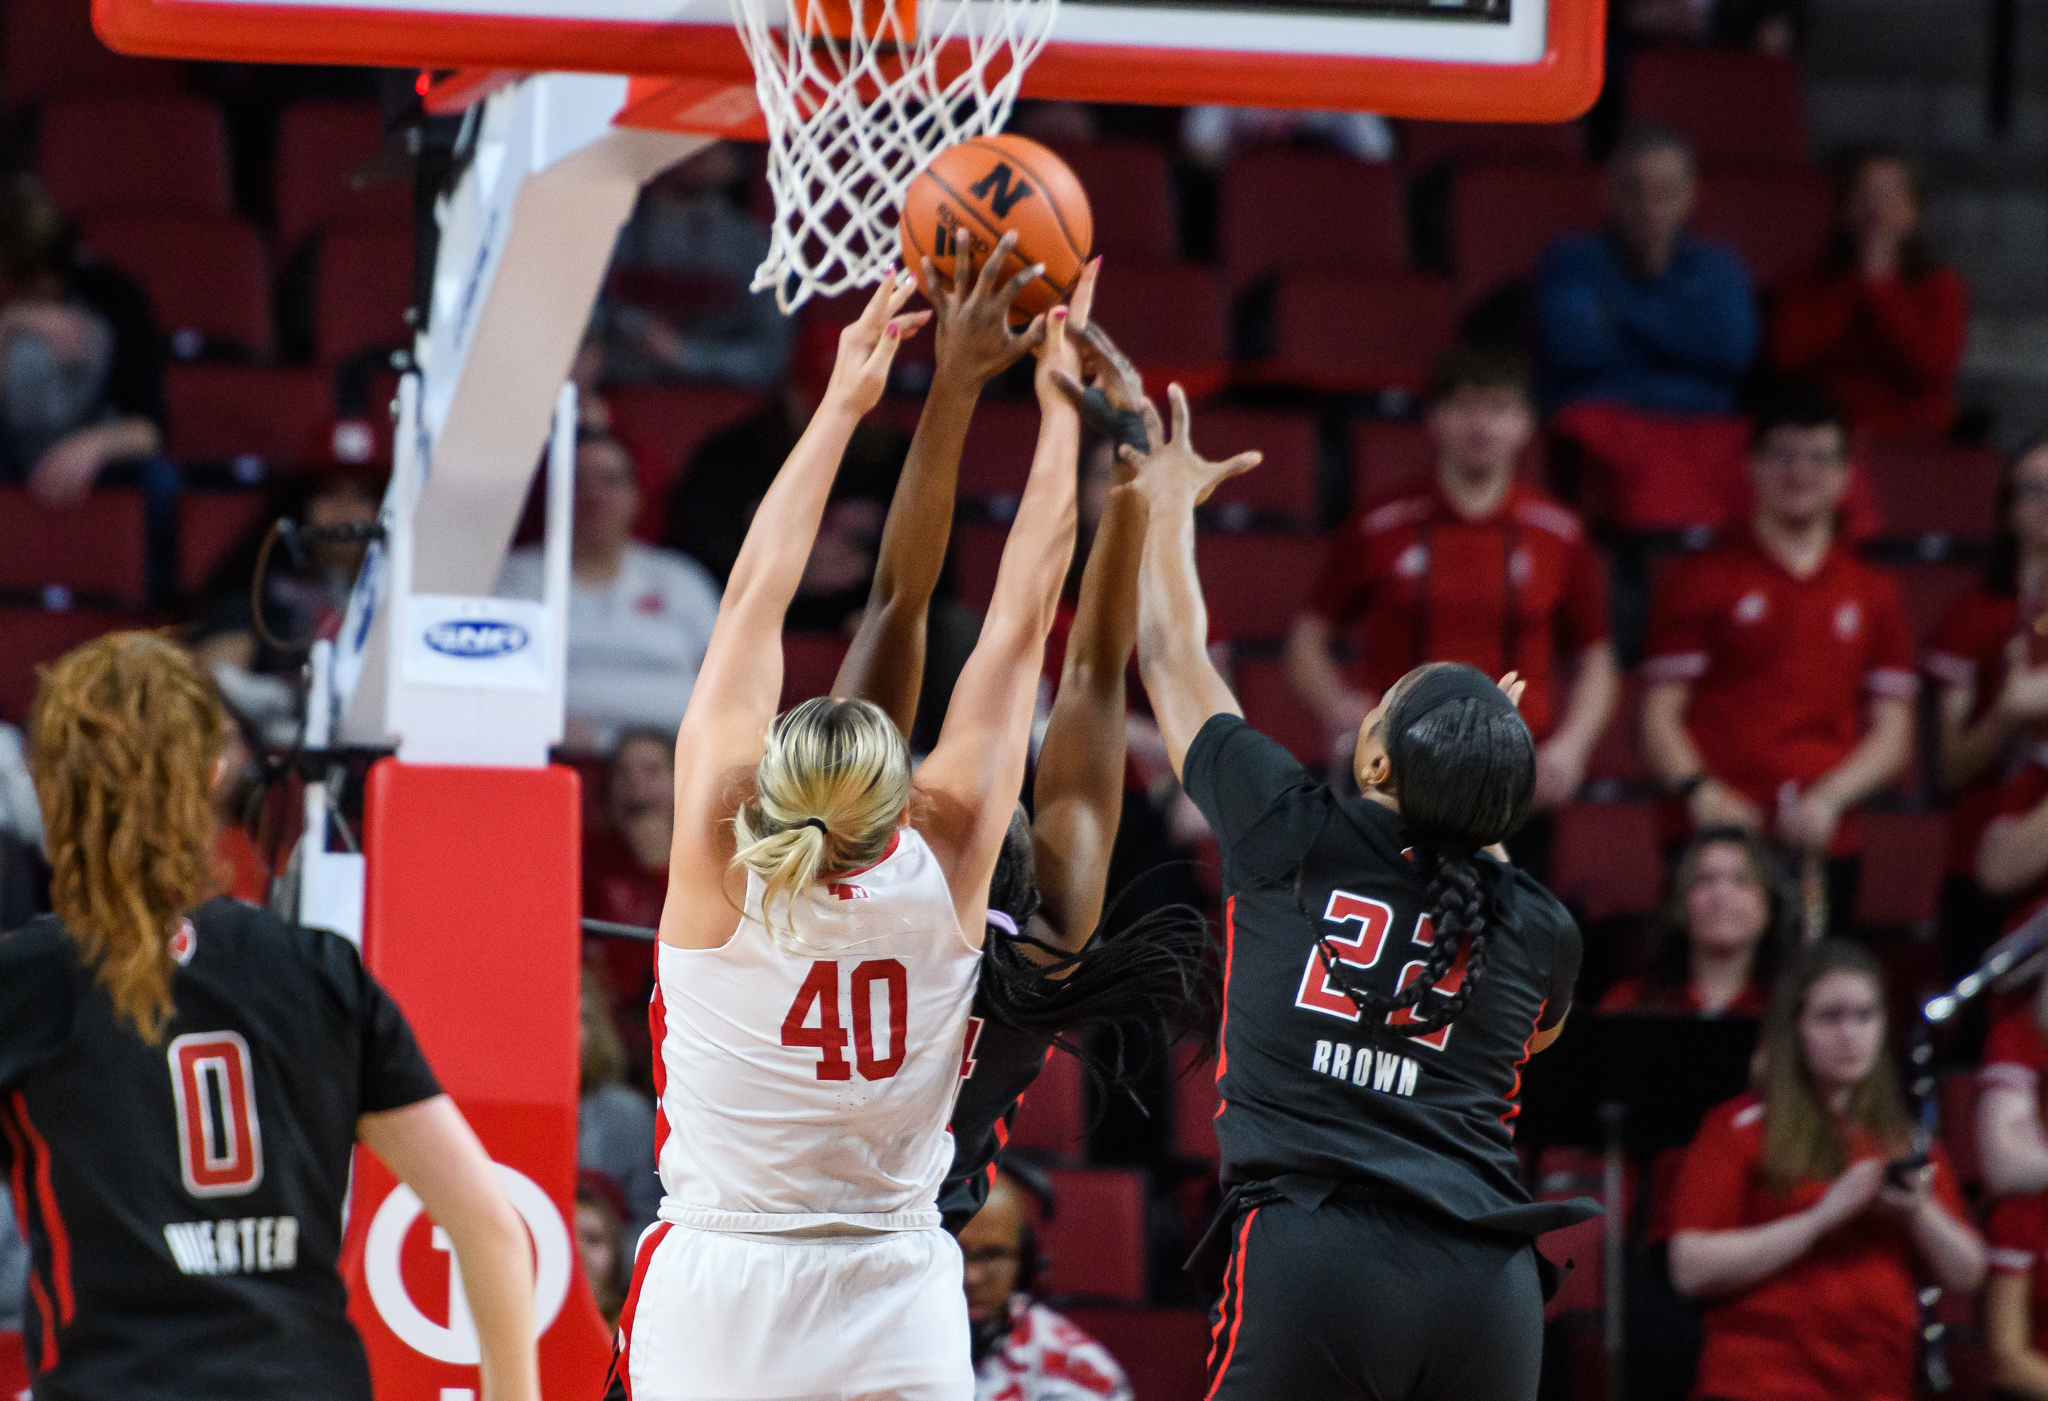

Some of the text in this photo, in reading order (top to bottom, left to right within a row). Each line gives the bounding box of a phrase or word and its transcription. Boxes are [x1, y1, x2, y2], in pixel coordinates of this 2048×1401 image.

[969, 161, 1034, 219] N
[781, 958, 907, 1082] 40
[1312, 1039, 1419, 1096] BROWN
[167, 1030, 264, 1199] 0
